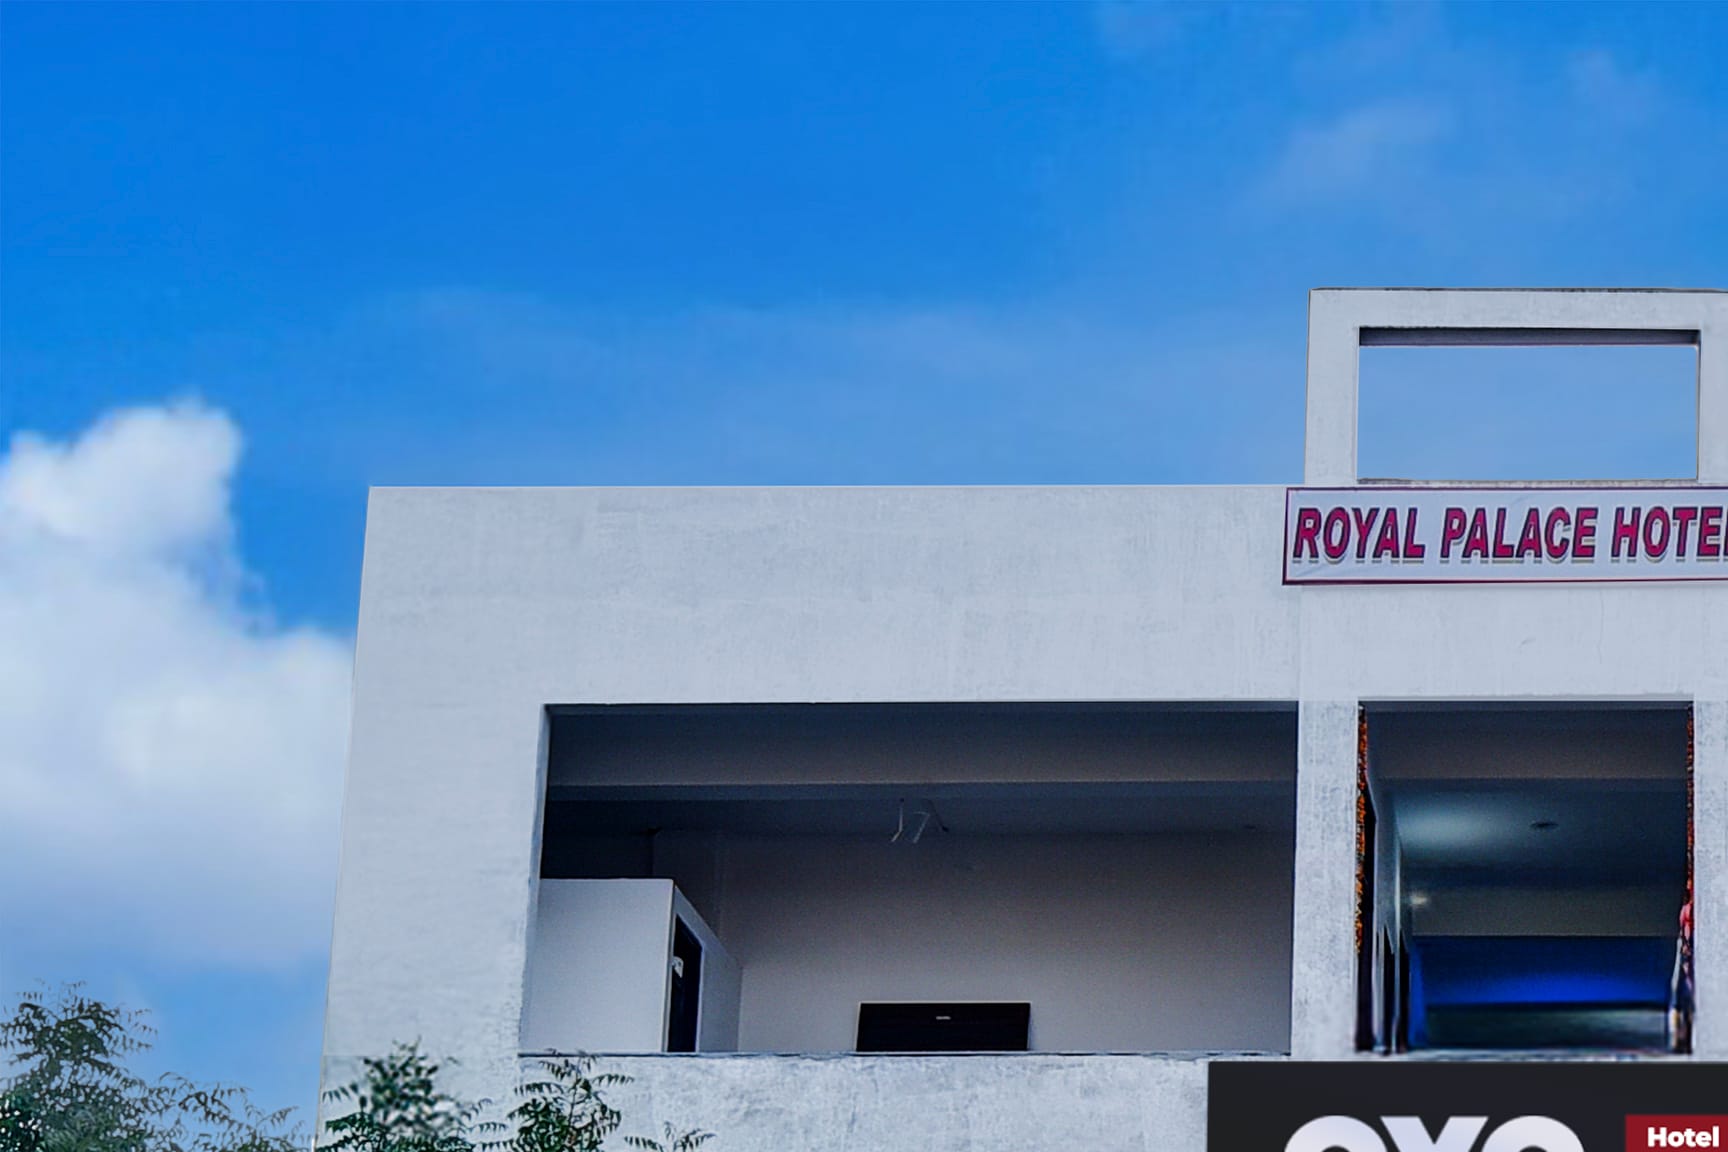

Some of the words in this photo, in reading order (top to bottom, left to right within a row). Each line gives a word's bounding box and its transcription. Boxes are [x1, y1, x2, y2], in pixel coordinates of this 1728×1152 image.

[1292, 506, 1427, 560] ROYAL
[1440, 506, 1600, 561] PALACE
[1647, 1125, 1720, 1148] Hotel
